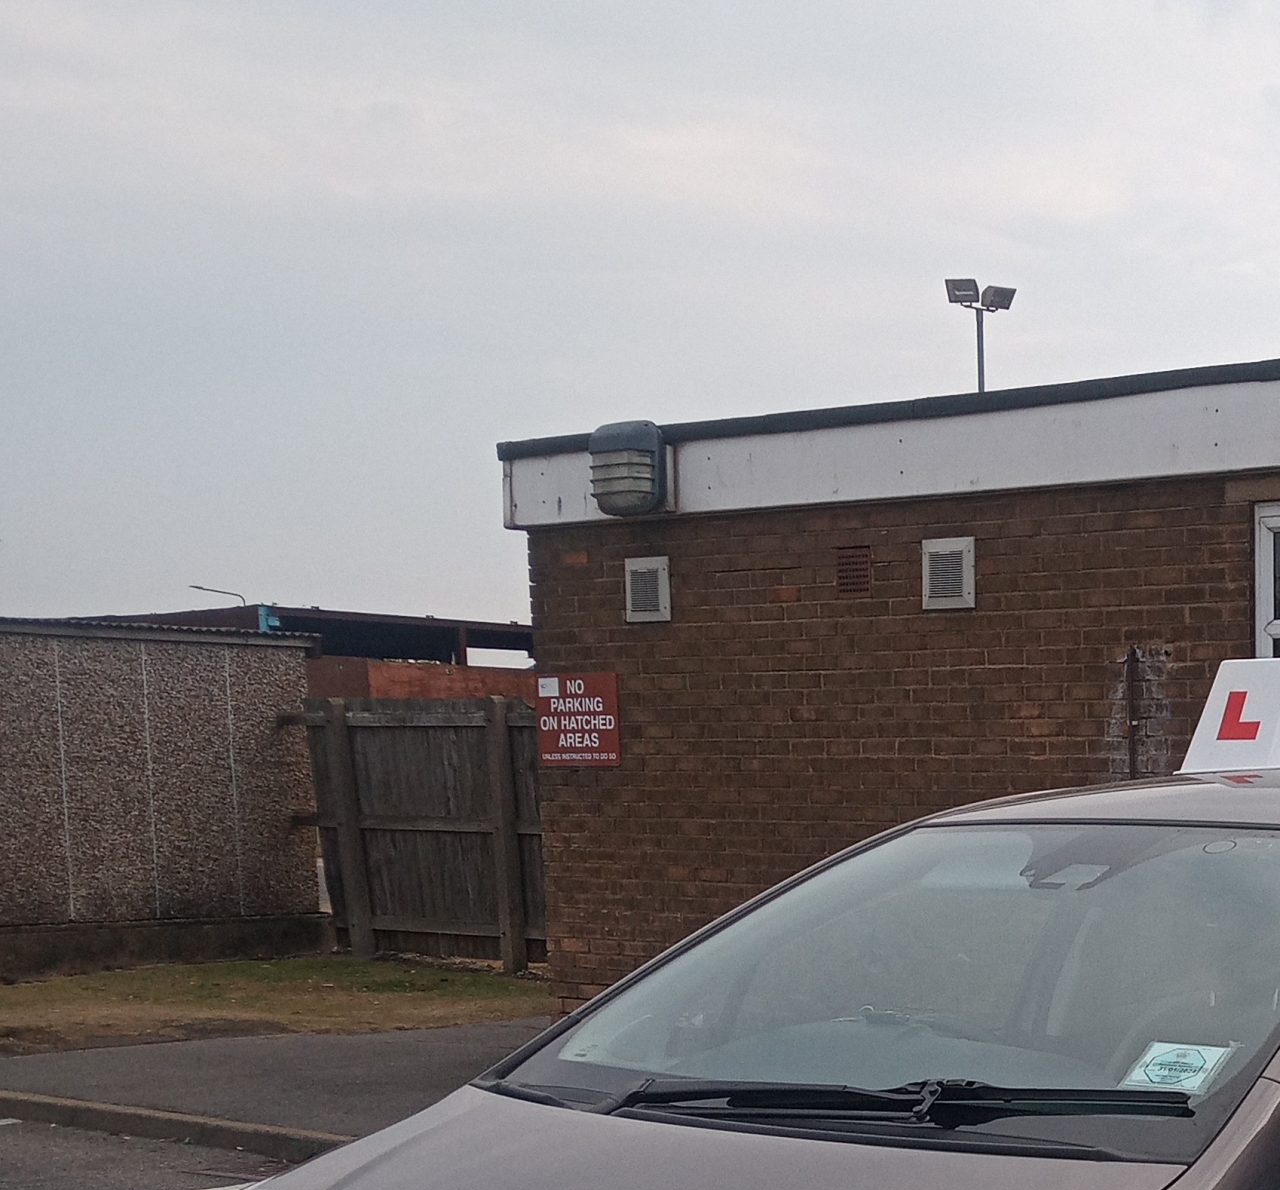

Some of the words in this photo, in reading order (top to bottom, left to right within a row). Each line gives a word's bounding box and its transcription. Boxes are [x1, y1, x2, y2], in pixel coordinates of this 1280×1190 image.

[566, 680, 584, 694] NO
[550, 697, 603, 712] PARKING
[540, 716, 557, 730] ON
[561, 715, 615, 730] HATCHED
[1216, 691, 1261, 741] L
[558, 733, 599, 747] AREAS
